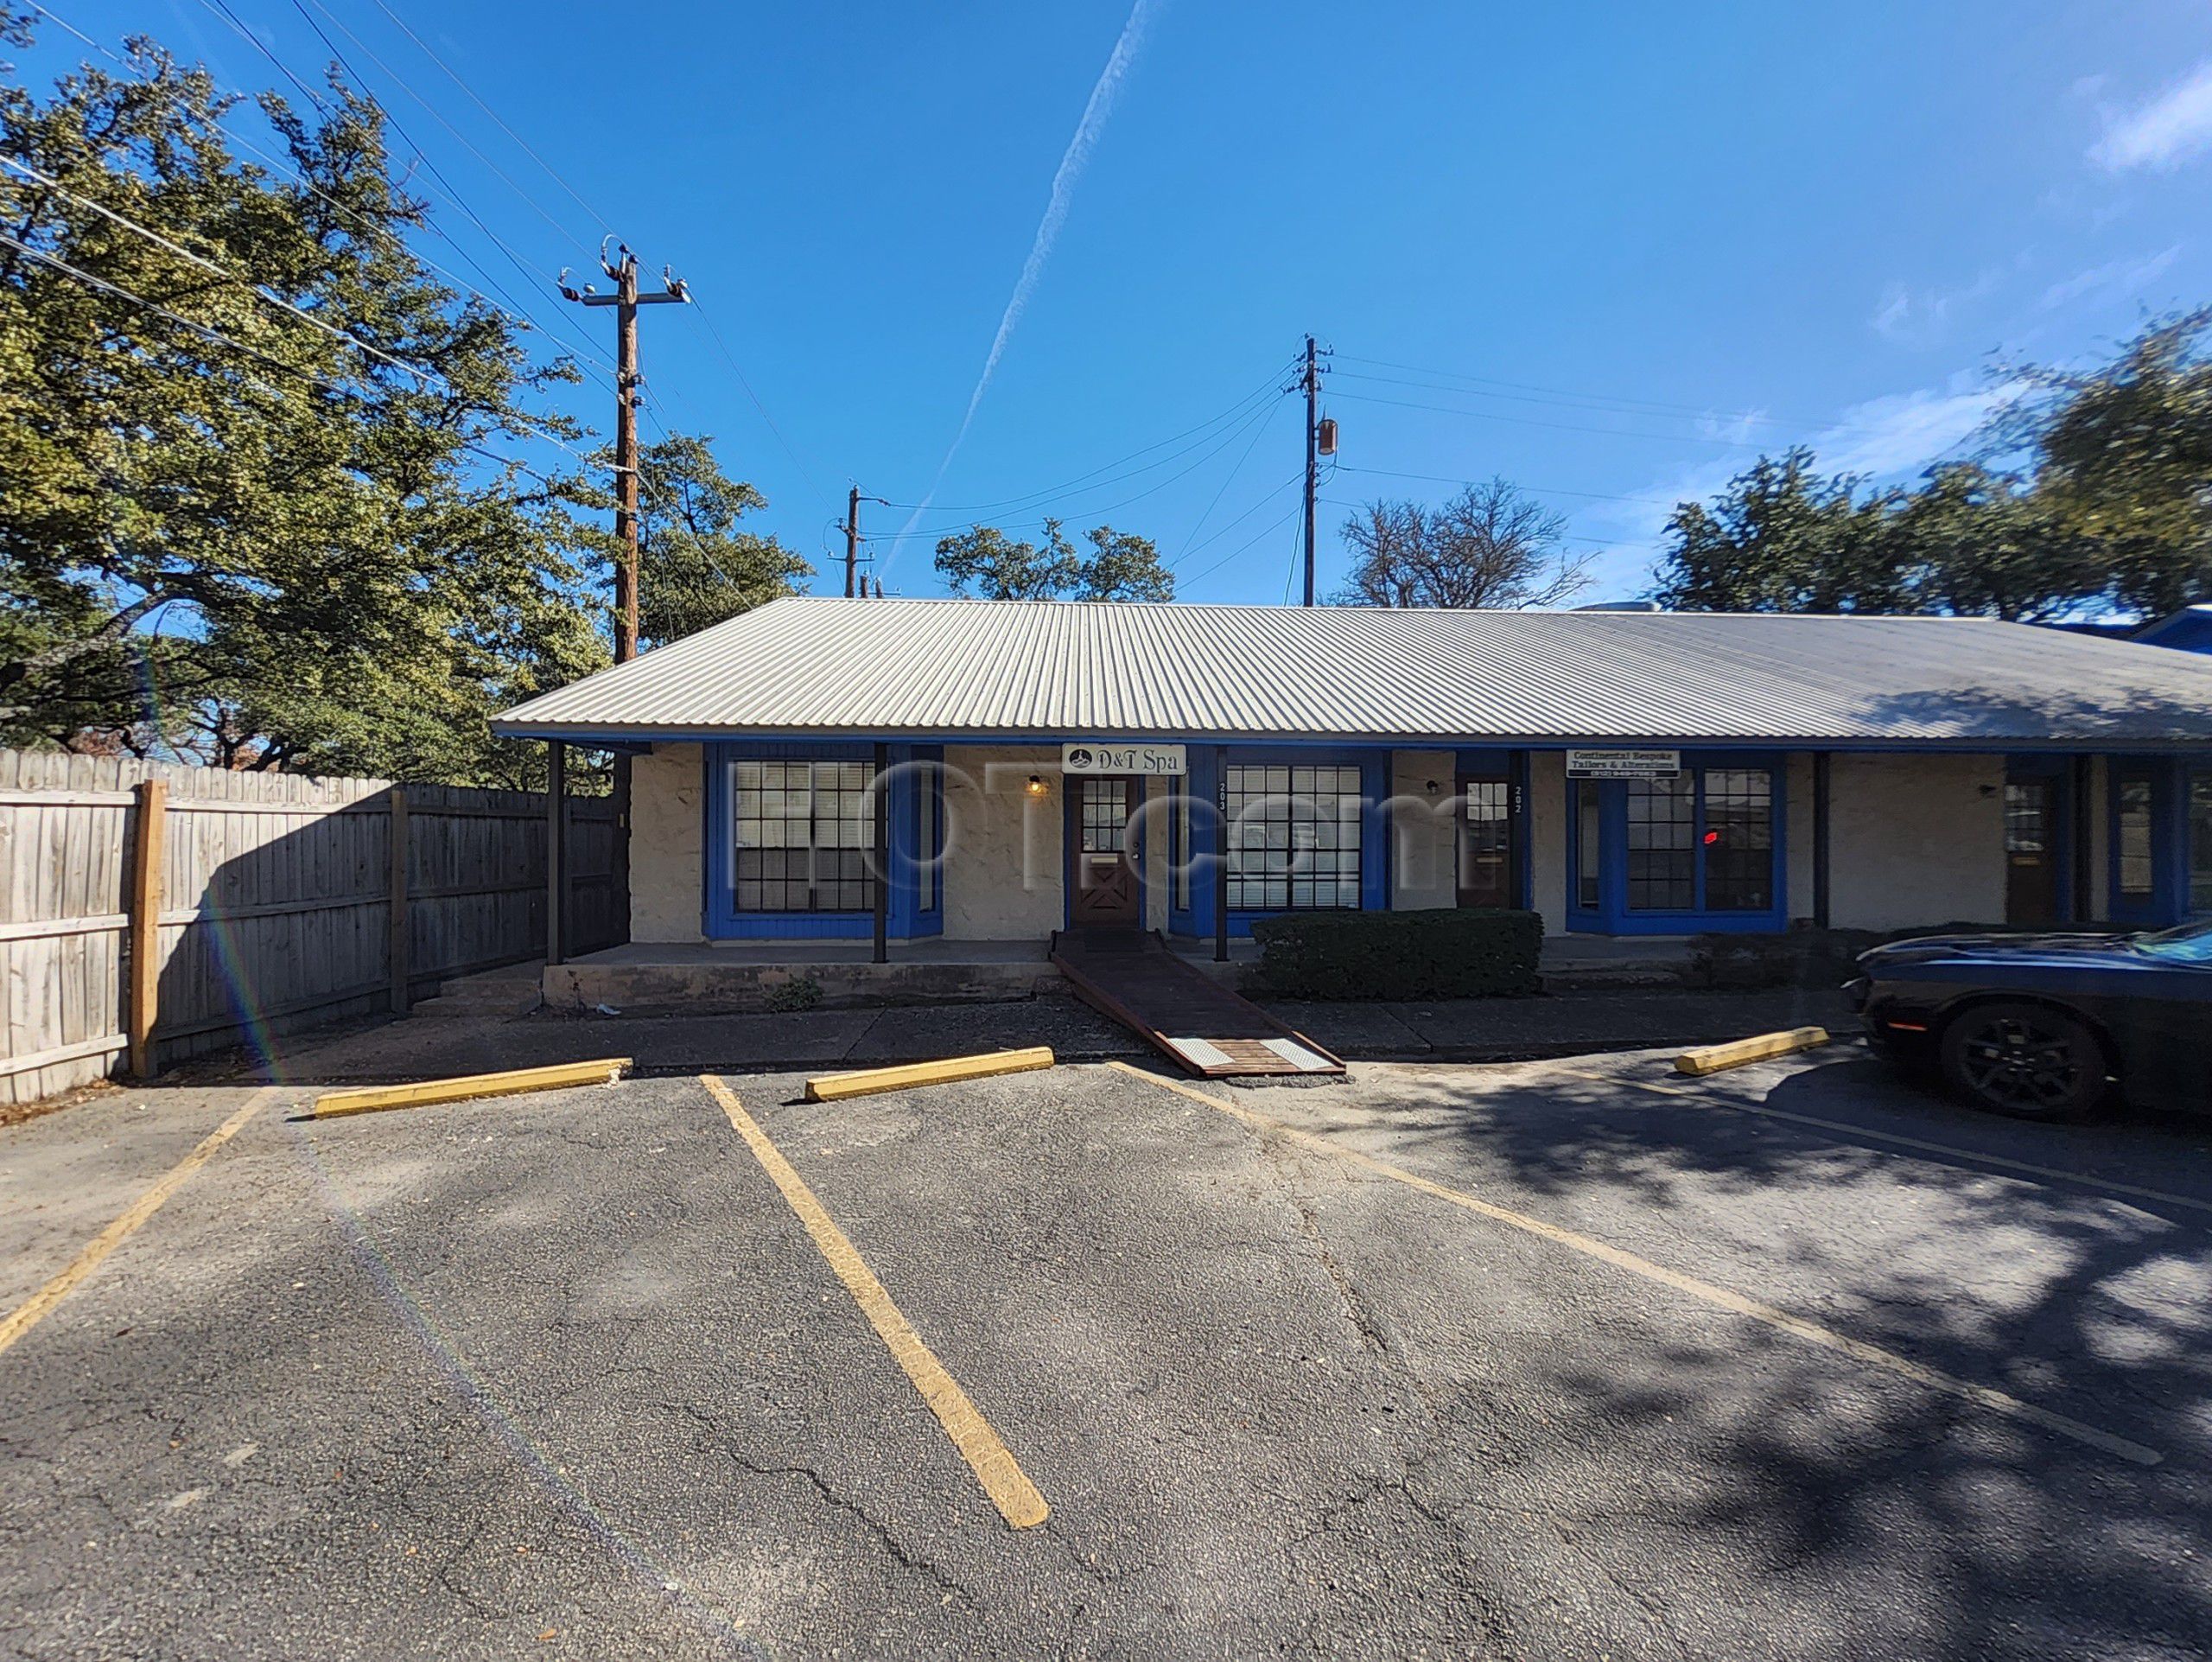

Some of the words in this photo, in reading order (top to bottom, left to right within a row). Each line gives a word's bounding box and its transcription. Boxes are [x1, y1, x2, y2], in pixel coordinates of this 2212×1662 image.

[1096, 748, 1138, 770] D&T
[1142, 748, 1179, 774] Spa
[1573, 751, 1630, 760] Continental
[1631, 752, 1674, 761] Bespoke
[1572, 761, 1607, 769] Tailors
[1609, 761, 1618, 769] &
[1620, 761, 1675, 769] Alterations
